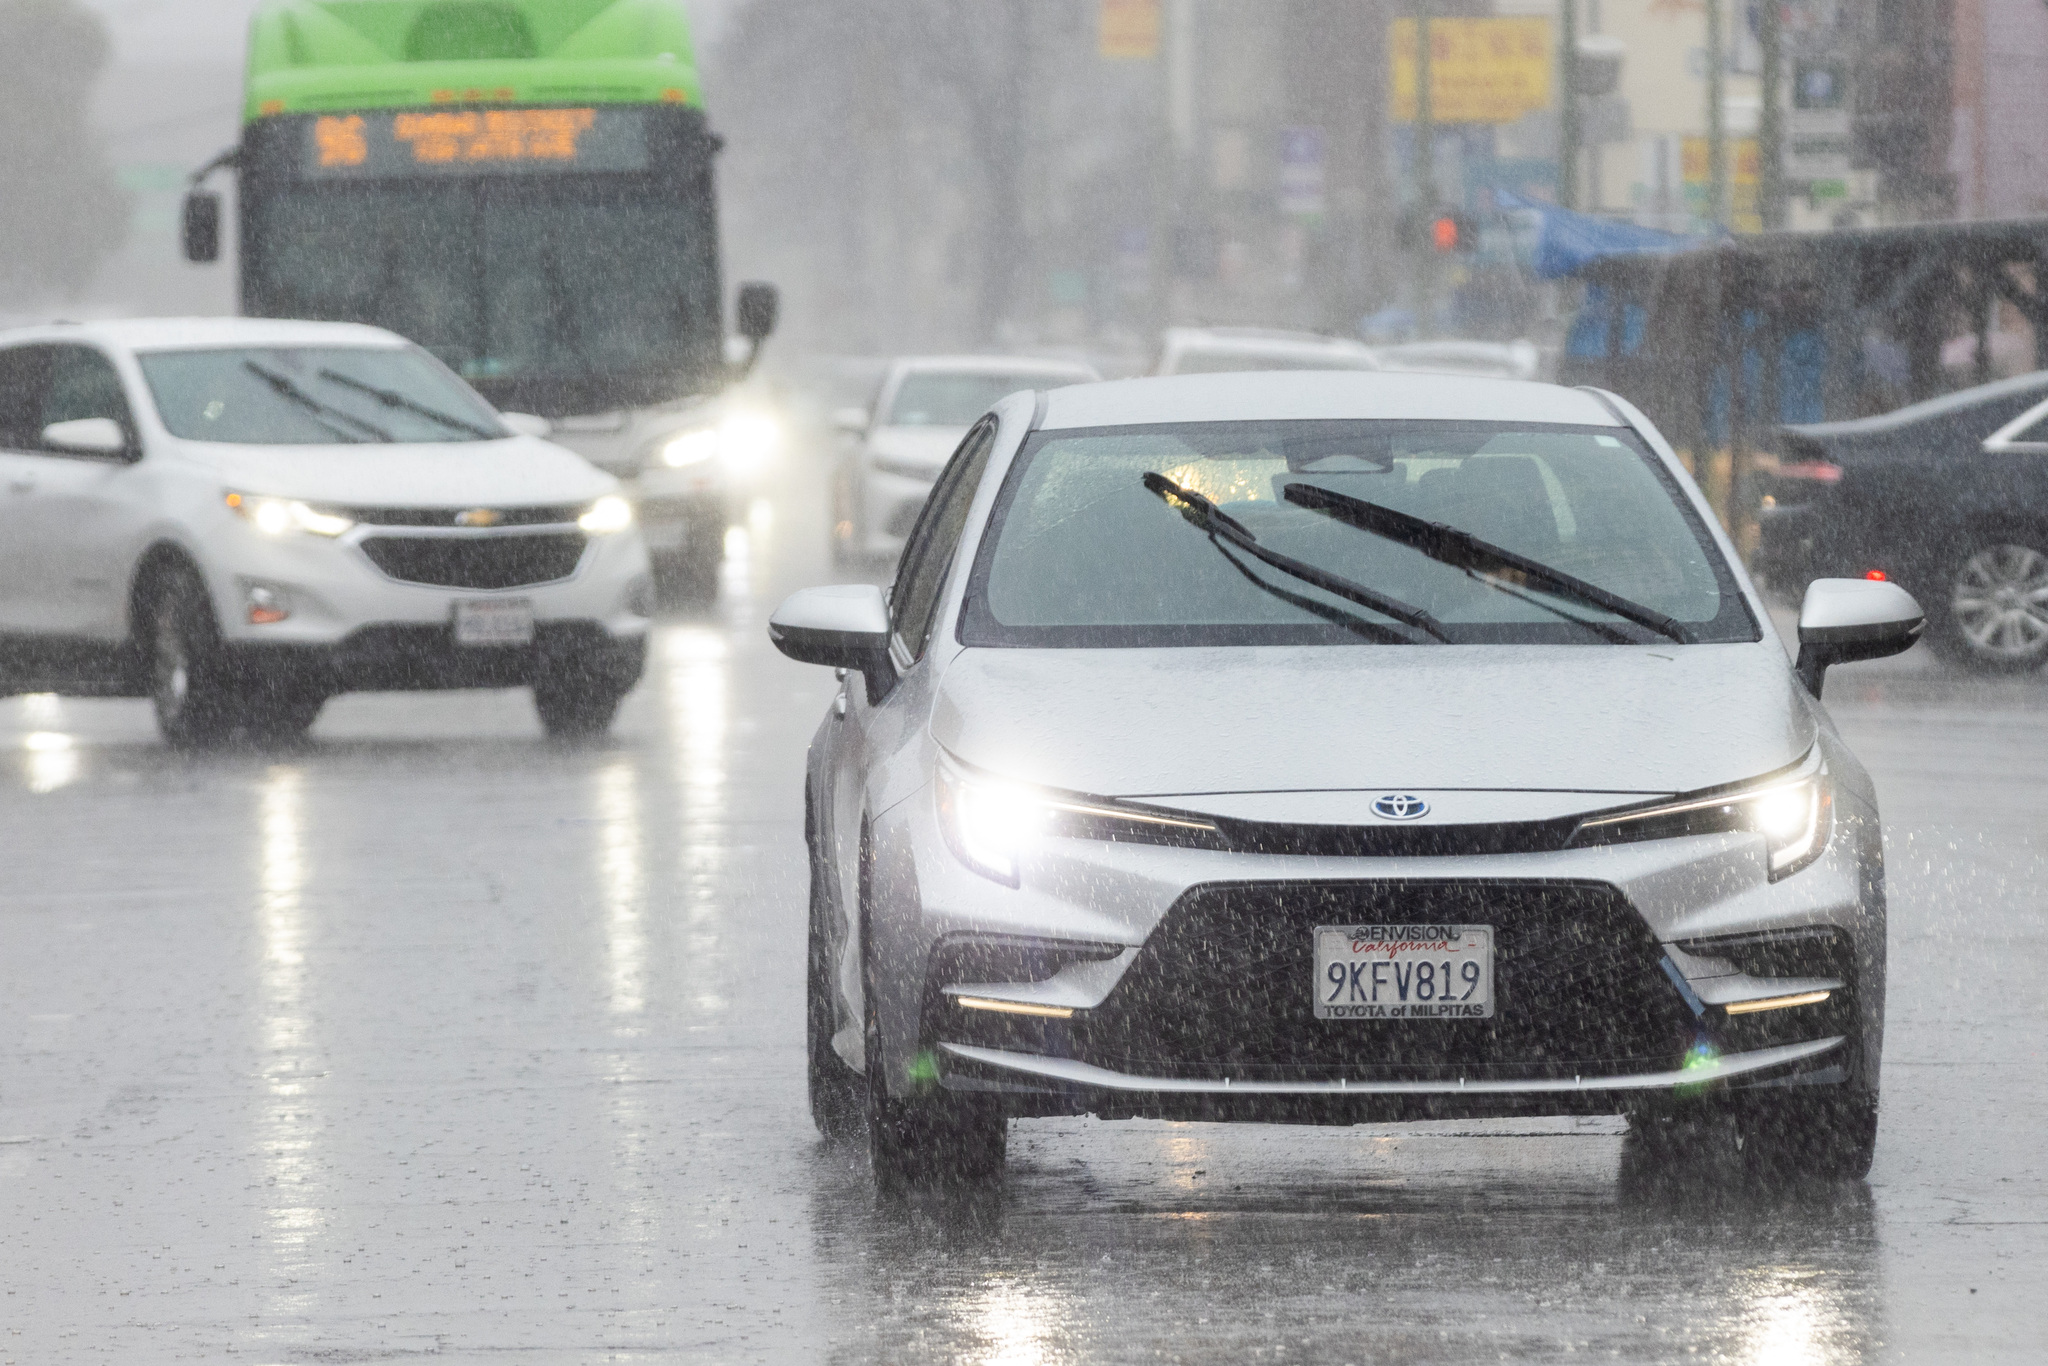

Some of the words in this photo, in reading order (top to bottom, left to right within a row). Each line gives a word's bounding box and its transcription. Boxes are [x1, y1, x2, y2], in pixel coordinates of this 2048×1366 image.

[1369, 926, 1453, 941] ENVISION
[1352, 940, 1460, 959] California
[1327, 960, 1480, 1002] 9KFV819
[1324, 1005, 1387, 1017] TOYOTA
[1391, 1004, 1407, 1017] of
[1410, 1004, 1484, 1017] MILPITAS
